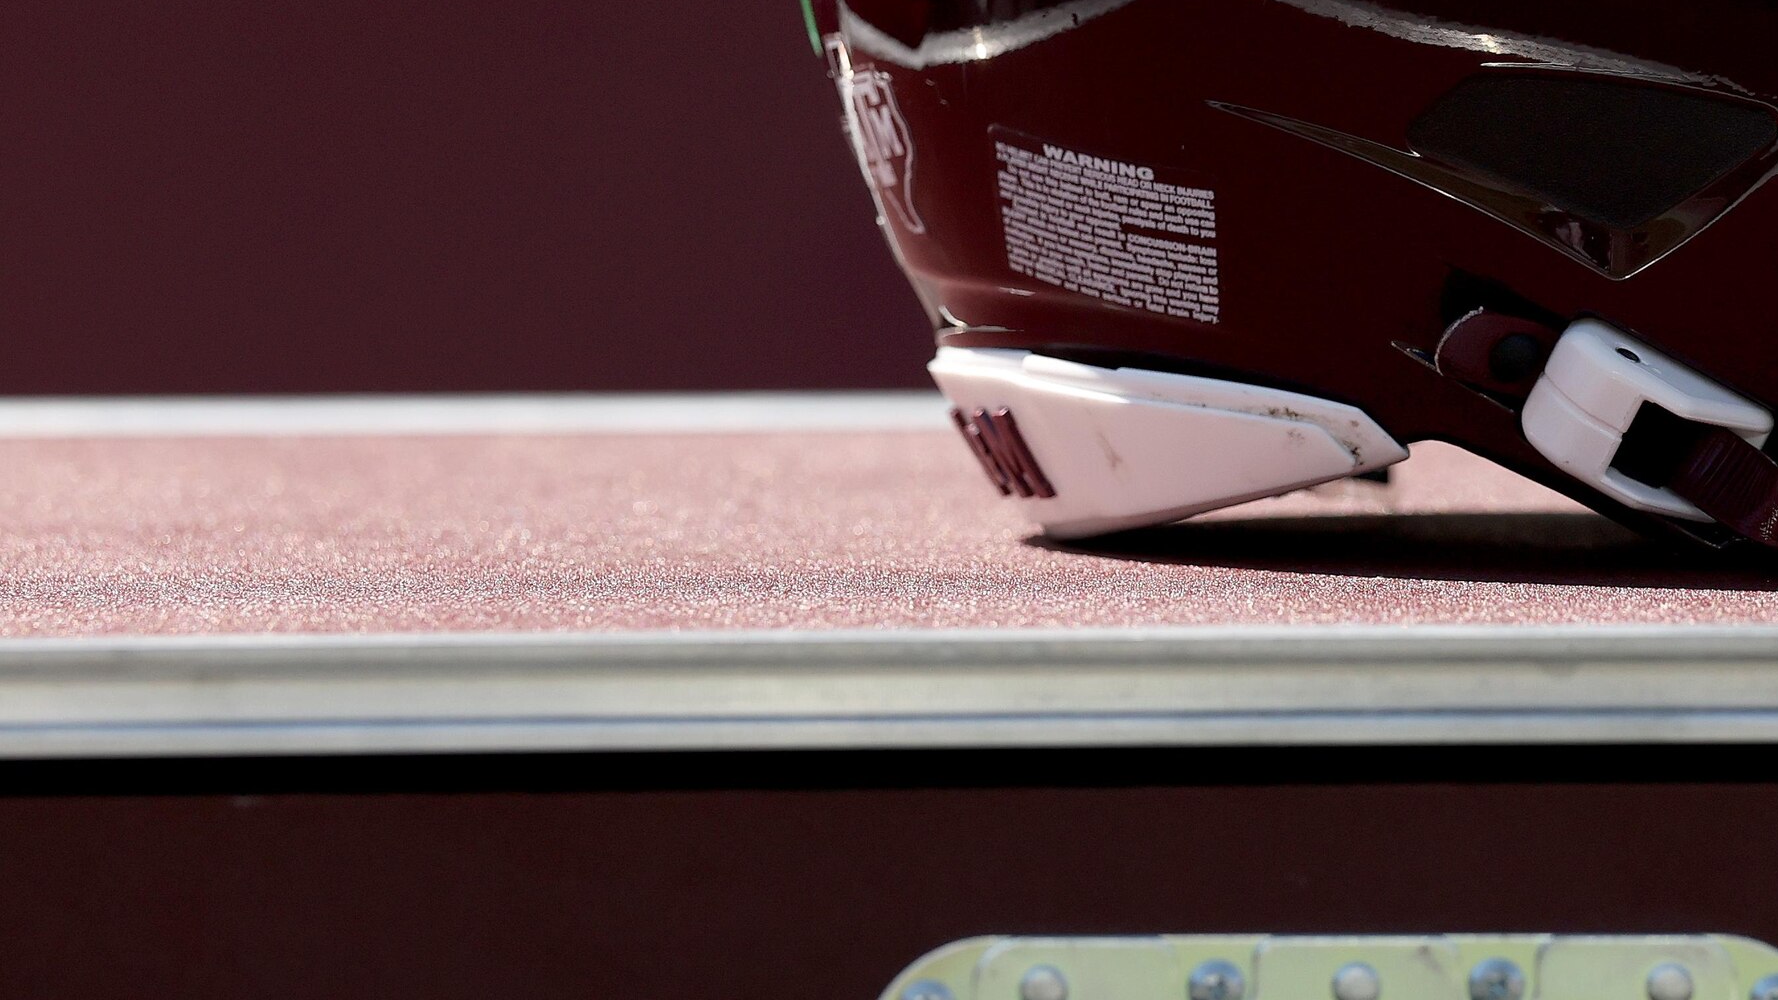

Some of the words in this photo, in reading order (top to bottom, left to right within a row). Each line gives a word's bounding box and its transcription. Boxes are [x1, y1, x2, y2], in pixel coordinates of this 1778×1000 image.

[1043, 144, 1154, 180] WARNING
[1139, 179, 1153, 191] OR
[1152, 181, 1176, 195] NECK
